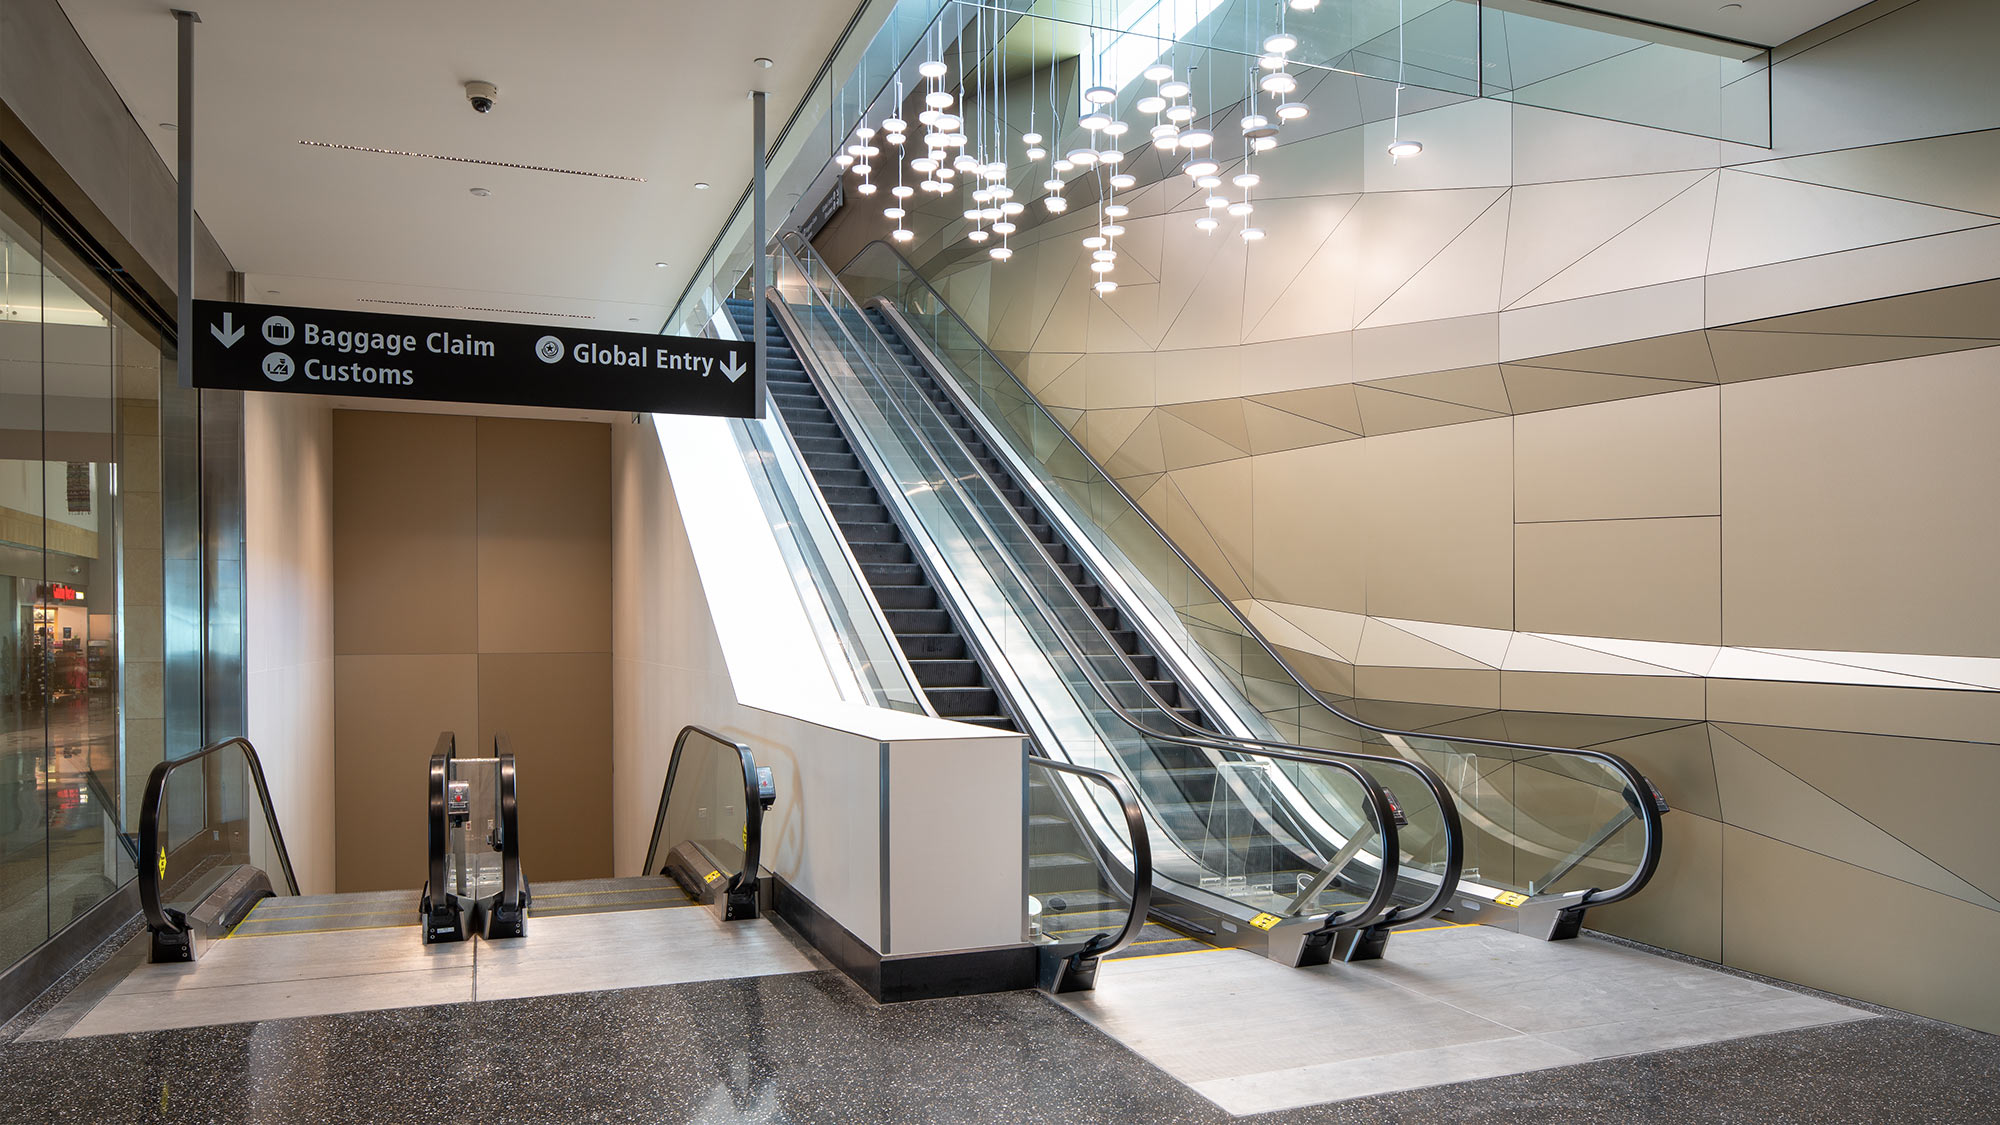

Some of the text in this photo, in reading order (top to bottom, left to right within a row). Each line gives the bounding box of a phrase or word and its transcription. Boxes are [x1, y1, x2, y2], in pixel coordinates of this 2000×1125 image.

[304, 323, 495, 357] Baggage Claim
[304, 358, 414, 386] Customs
[573, 342, 714, 378] Global Entry
